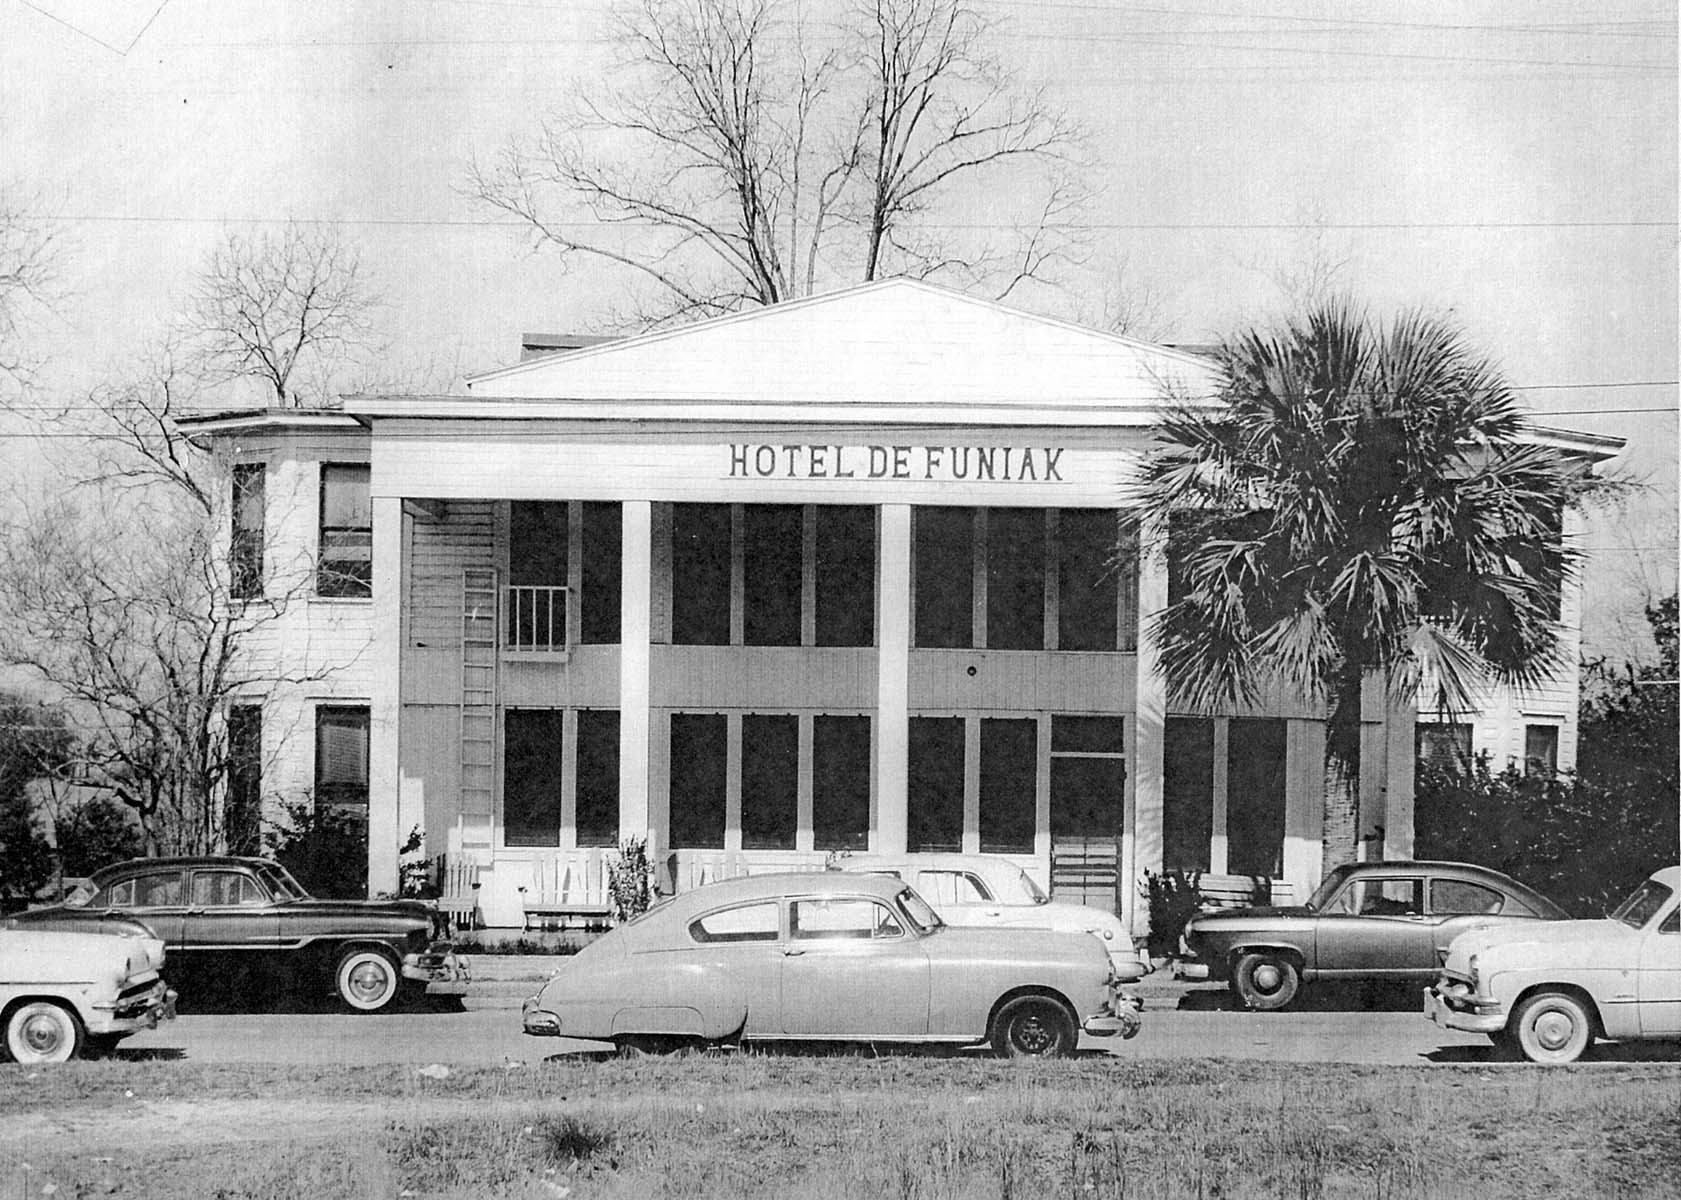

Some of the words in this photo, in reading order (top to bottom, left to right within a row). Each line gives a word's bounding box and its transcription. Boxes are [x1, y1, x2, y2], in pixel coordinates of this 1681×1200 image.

[730, 444, 854, 478] HOTEL
[868, 446, 911, 479] DE
[925, 447, 1064, 481] FUNIAK
